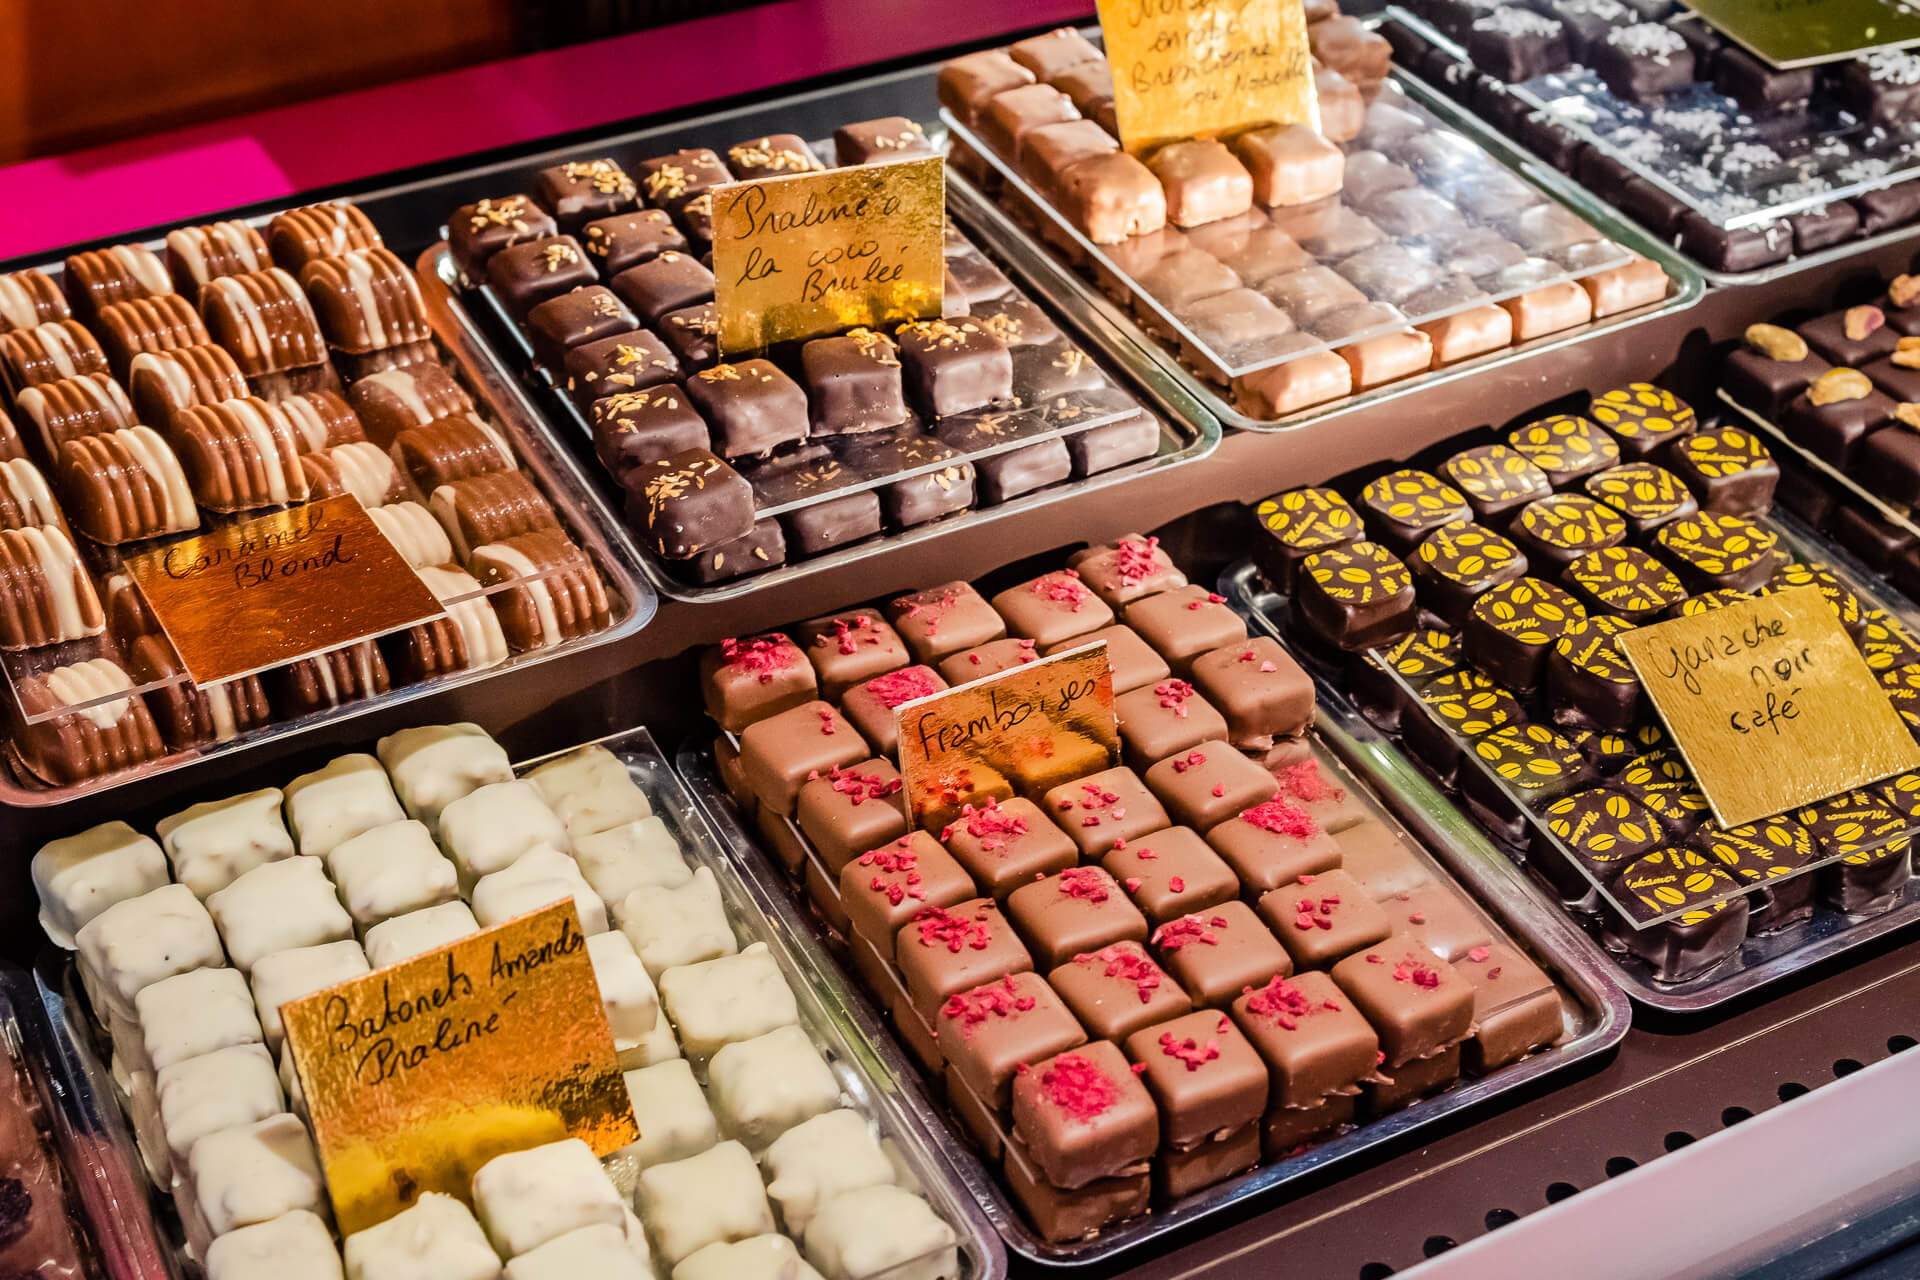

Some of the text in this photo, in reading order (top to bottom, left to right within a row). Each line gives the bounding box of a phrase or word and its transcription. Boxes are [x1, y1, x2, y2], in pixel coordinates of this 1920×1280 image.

[728, 181, 884, 240] Praliné
[735, 240, 880, 287] la coco
[163, 507, 329, 579] Caramel
[234, 534, 354, 589] Blond
[1730, 687, 1802, 735] café
[323, 951, 473, 1055] Batonets
[354, 990, 518, 1087] Praliné
